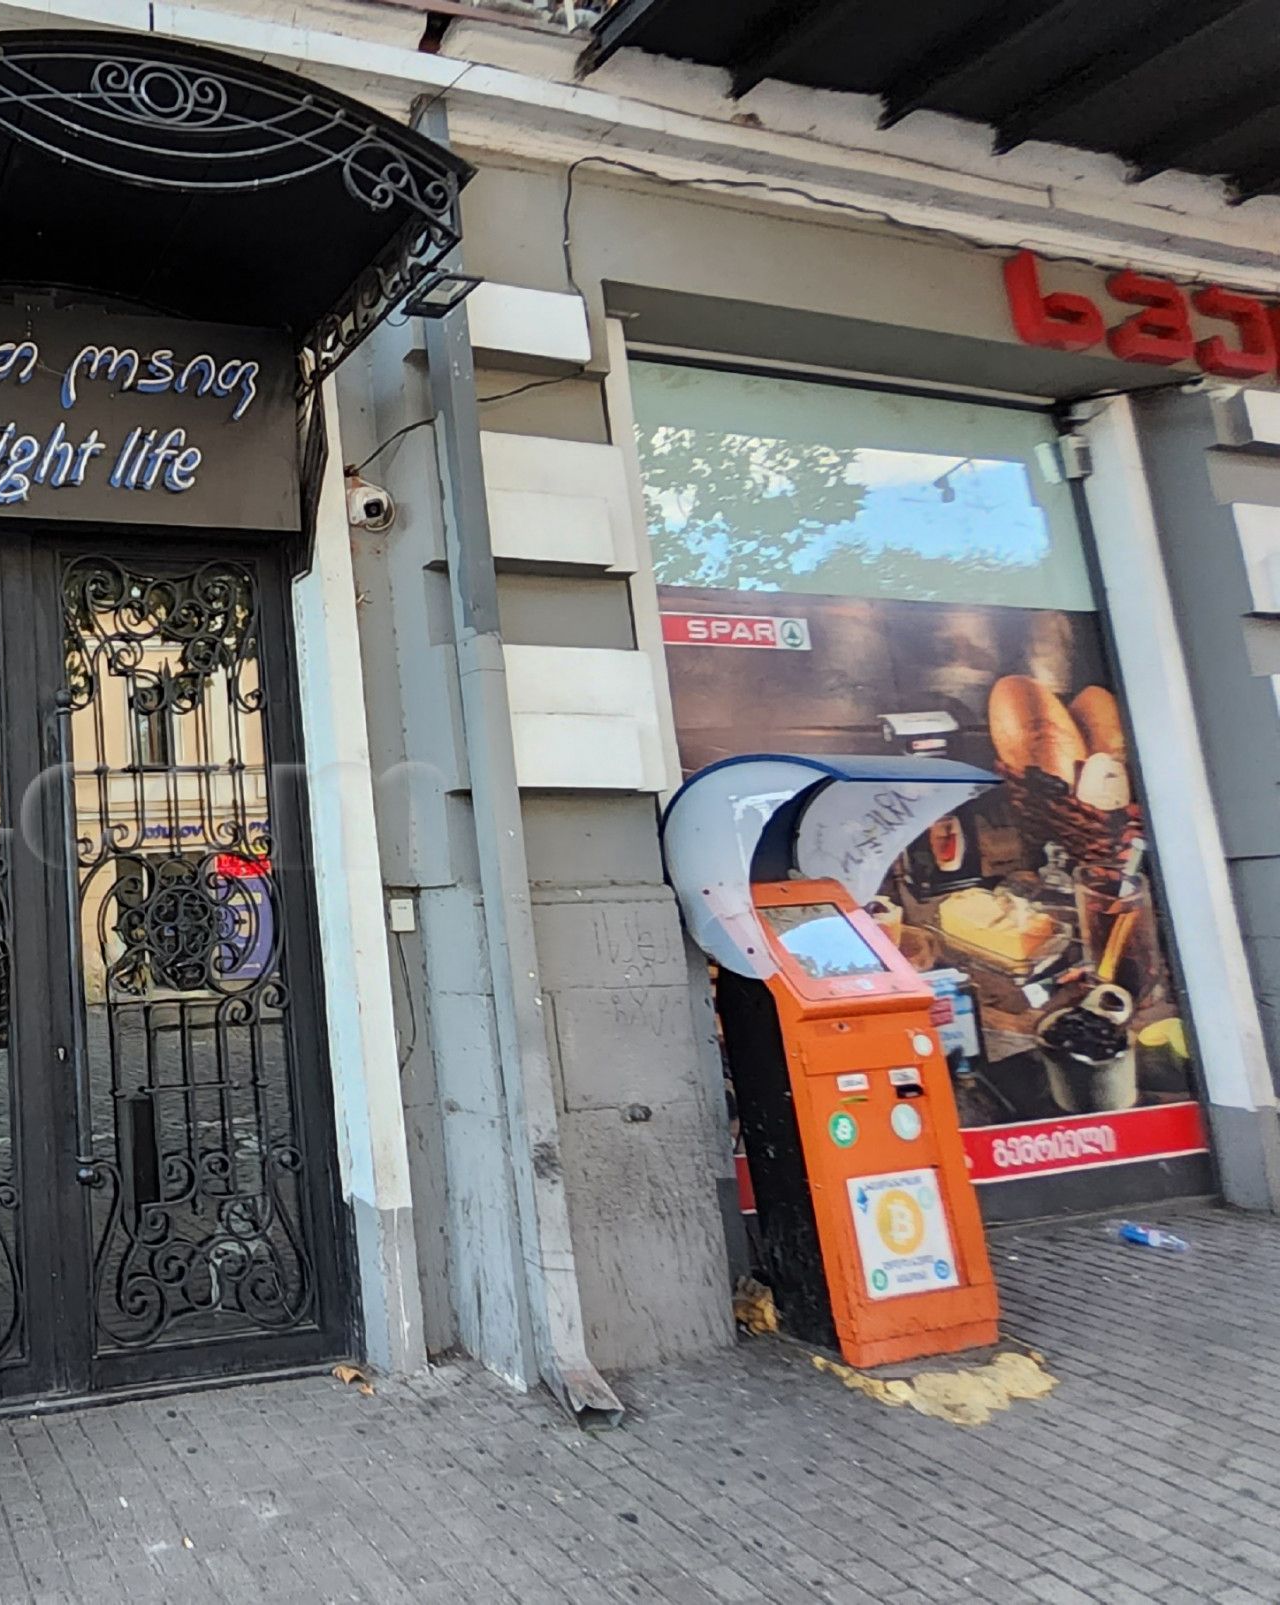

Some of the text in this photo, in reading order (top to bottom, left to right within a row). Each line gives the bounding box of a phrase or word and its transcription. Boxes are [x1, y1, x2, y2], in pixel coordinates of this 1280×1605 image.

[1003, 249, 1280, 384] სპა
[110, 428, 201, 491] life
[686, 619, 775, 642] SPAR
